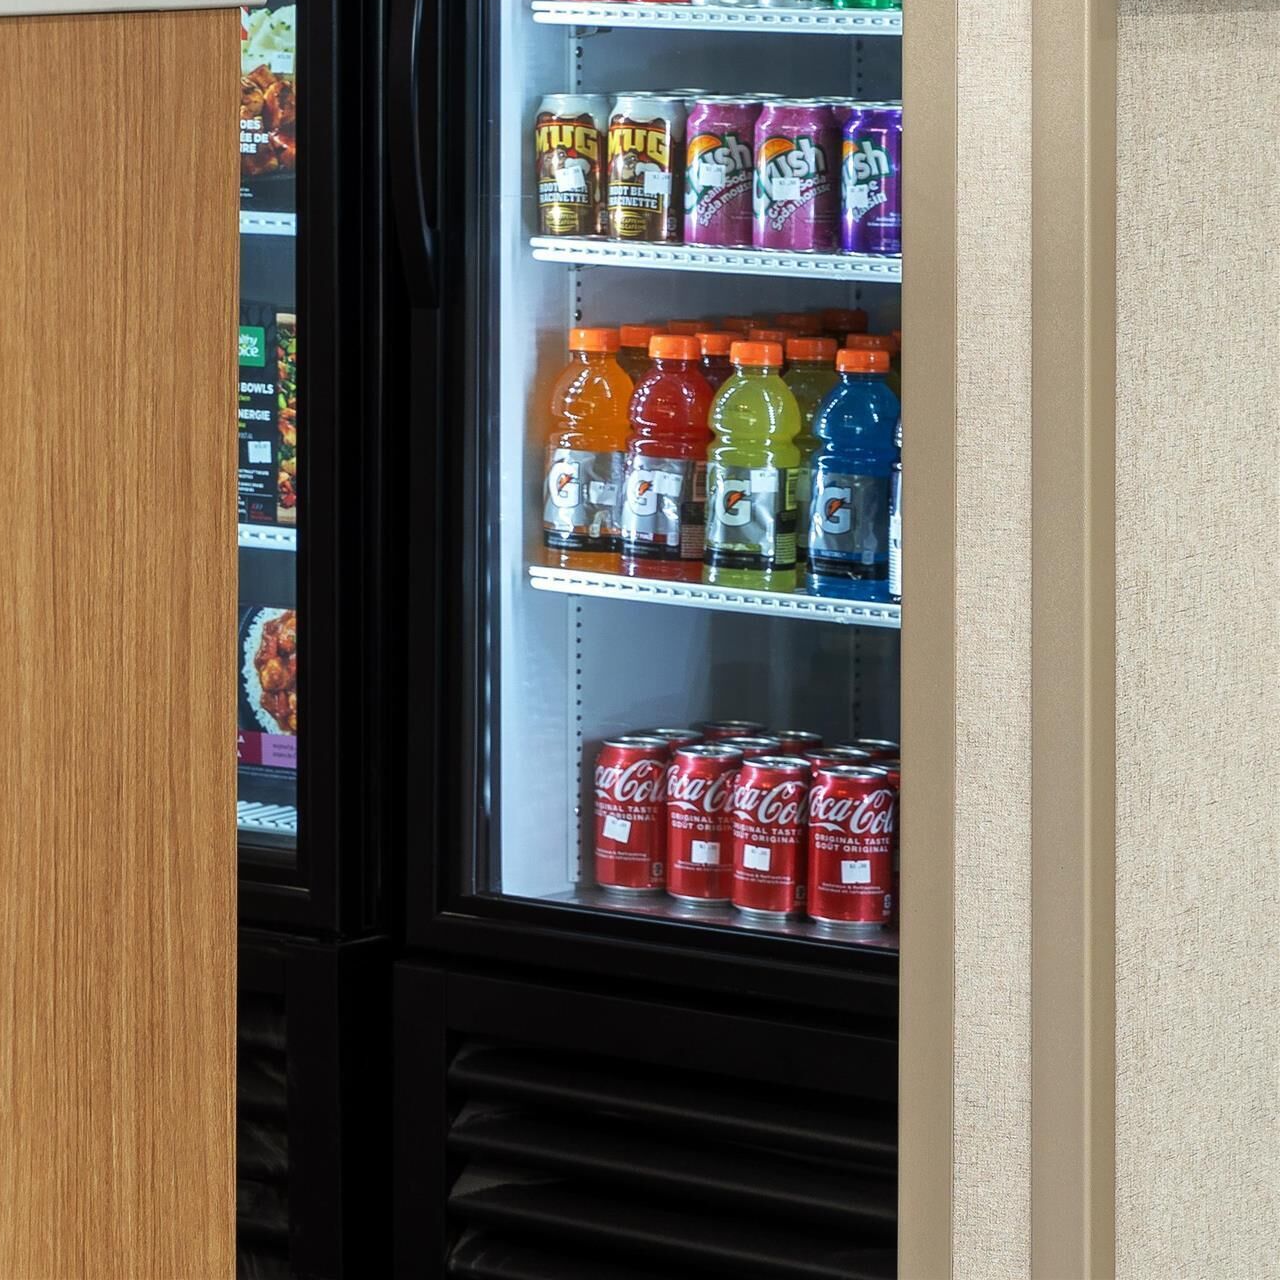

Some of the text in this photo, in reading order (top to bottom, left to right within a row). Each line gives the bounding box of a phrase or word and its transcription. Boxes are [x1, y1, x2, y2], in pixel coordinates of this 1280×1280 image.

[253, 133, 269, 143] DE
[536, 125, 599, 161] MUG
[608, 127, 670, 166] MUG
[699, 197, 722, 227] Soda
[768, 200, 786, 219] Cre
[772, 204, 796, 231] Soda
[241, 382, 274, 395] BOWLS
[238, 409, 272, 422] NERGIE
[548, 460, 580, 509] G
[625, 470, 658, 517] G
[715, 478, 752, 527] G
[819, 485, 853, 535] G
[671, 812, 713, 824] ORIGINAL
[809, 785, 893, 835] Coca-Col
[815, 833, 889, 846] ORIGINAL TASTE
[815, 841, 888, 853] GOÛT ORIGINAL
